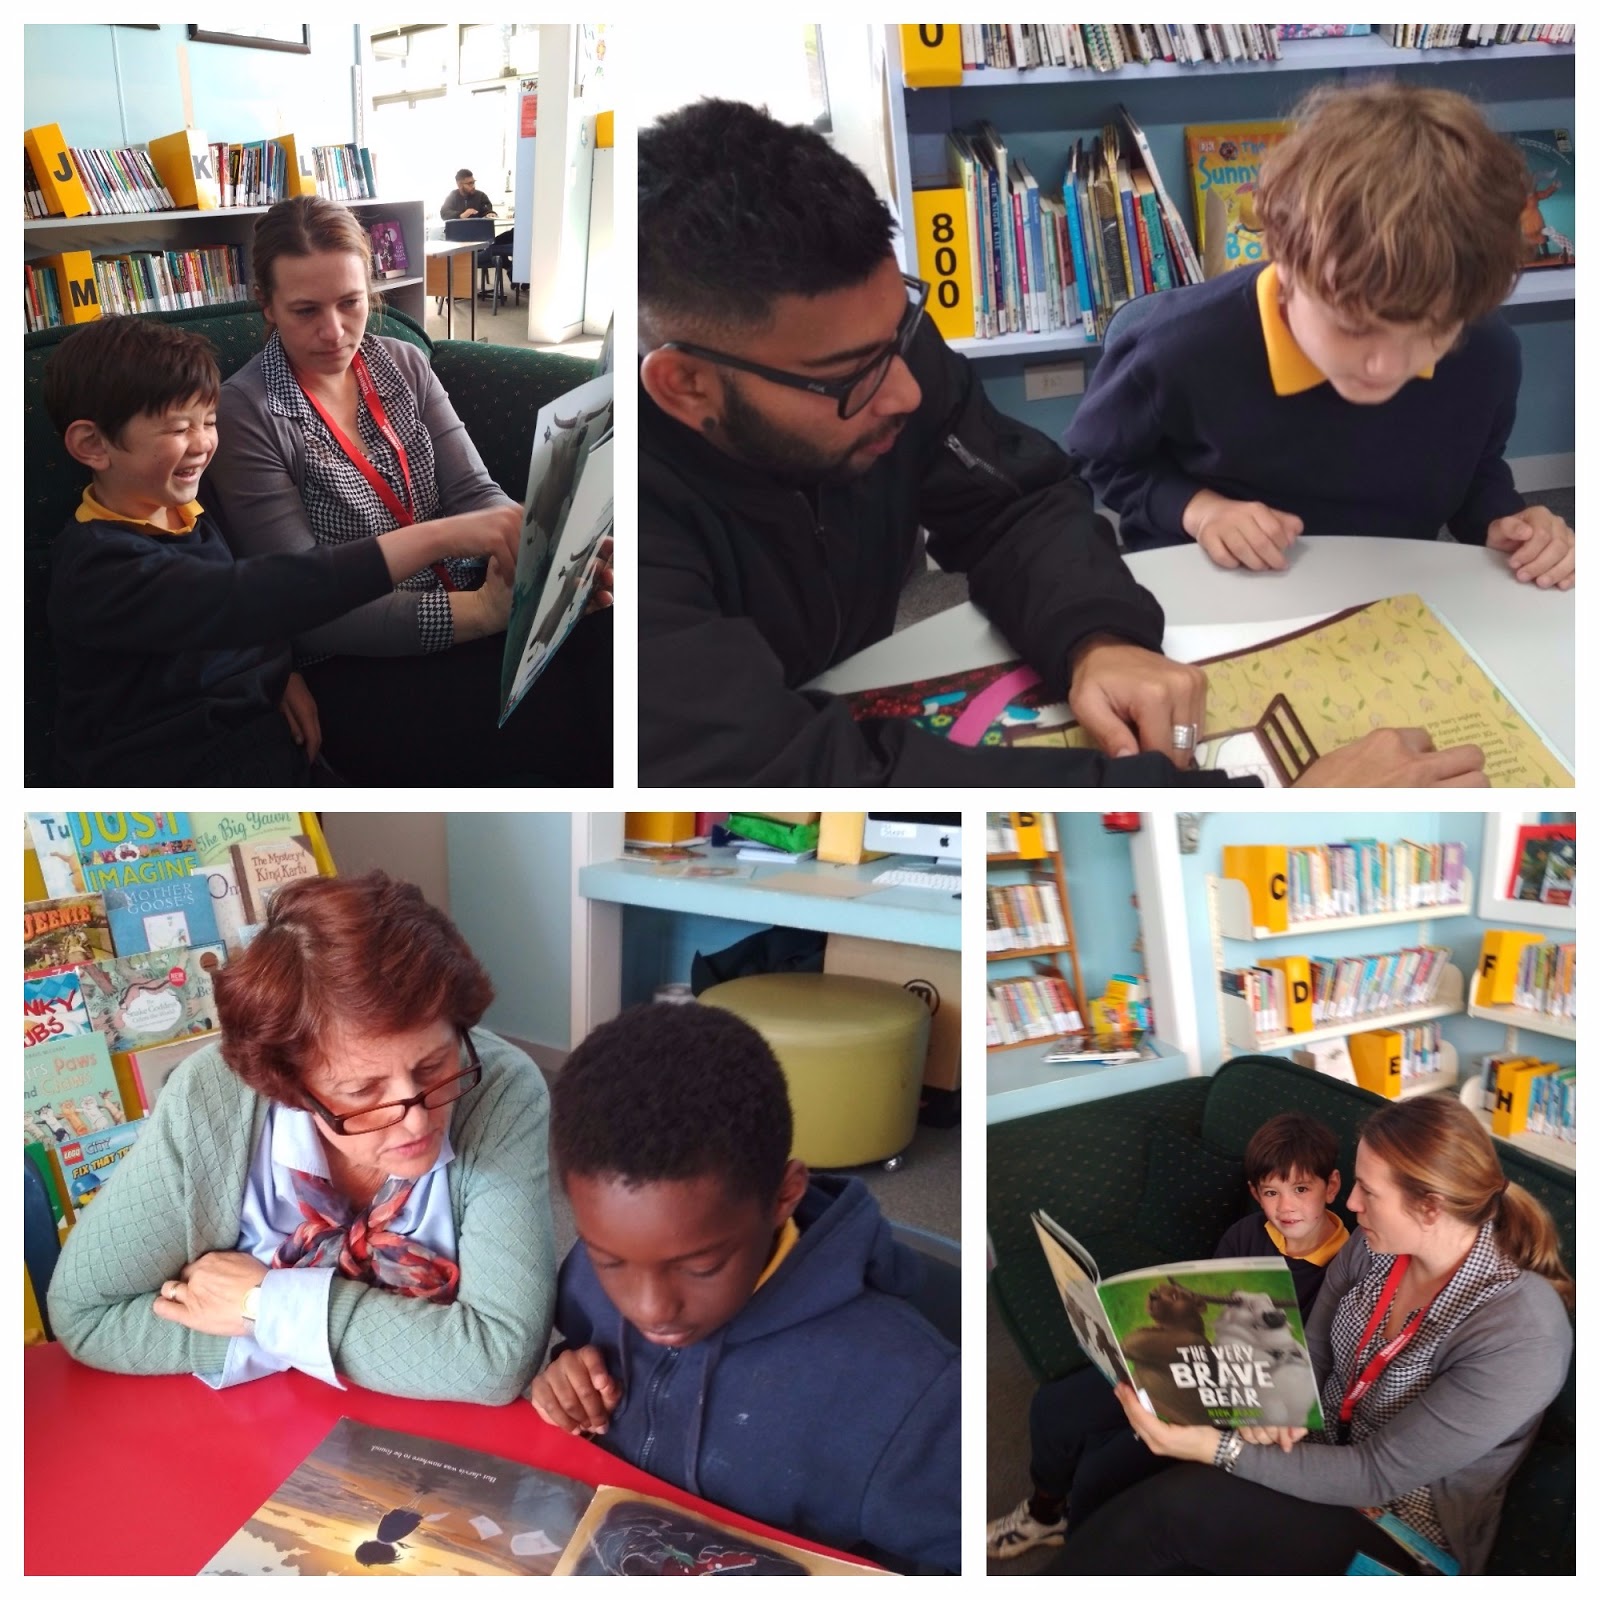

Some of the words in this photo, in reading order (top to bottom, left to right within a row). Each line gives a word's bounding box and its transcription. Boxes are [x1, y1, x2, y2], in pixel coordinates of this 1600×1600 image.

[53, 151, 74, 182] J
[192, 154, 212, 180] K
[300, 154, 313, 177] L
[69, 279, 98, 308] M
[196, 831, 217, 852] The
[218, 817, 247, 841] Big
[251, 857, 268, 867] The
[268, 852, 300, 865] Mystery
[255, 868, 281, 882] King
[280, 862, 308, 878] Karfu
[122, 882, 193, 904] MOTHER
[1270, 872, 1287, 901] C
[1482, 953, 1498, 978] F
[1293, 980, 1309, 1004] D
[54, 1053, 97, 1074] Paws
[1389, 1055, 1400, 1076] E
[1496, 1087, 1513, 1114] H
[64, 1147, 80, 1160] LEGO
[72, 1163, 90, 1180] FIX
[91, 1152, 117, 1171] THAT
[1176, 1344, 1209, 1363] THE
[1210, 1343, 1254, 1363] VERY
[1169, 1360, 1275, 1389] BRAVE
[1198, 1387, 1262, 1408] BEAR
[393, 1450, 402, 1459] be
[412, 1455, 443, 1468] nowhere
[443, 1463, 457, 1472] was
[483, 1473, 497, 1484] But
